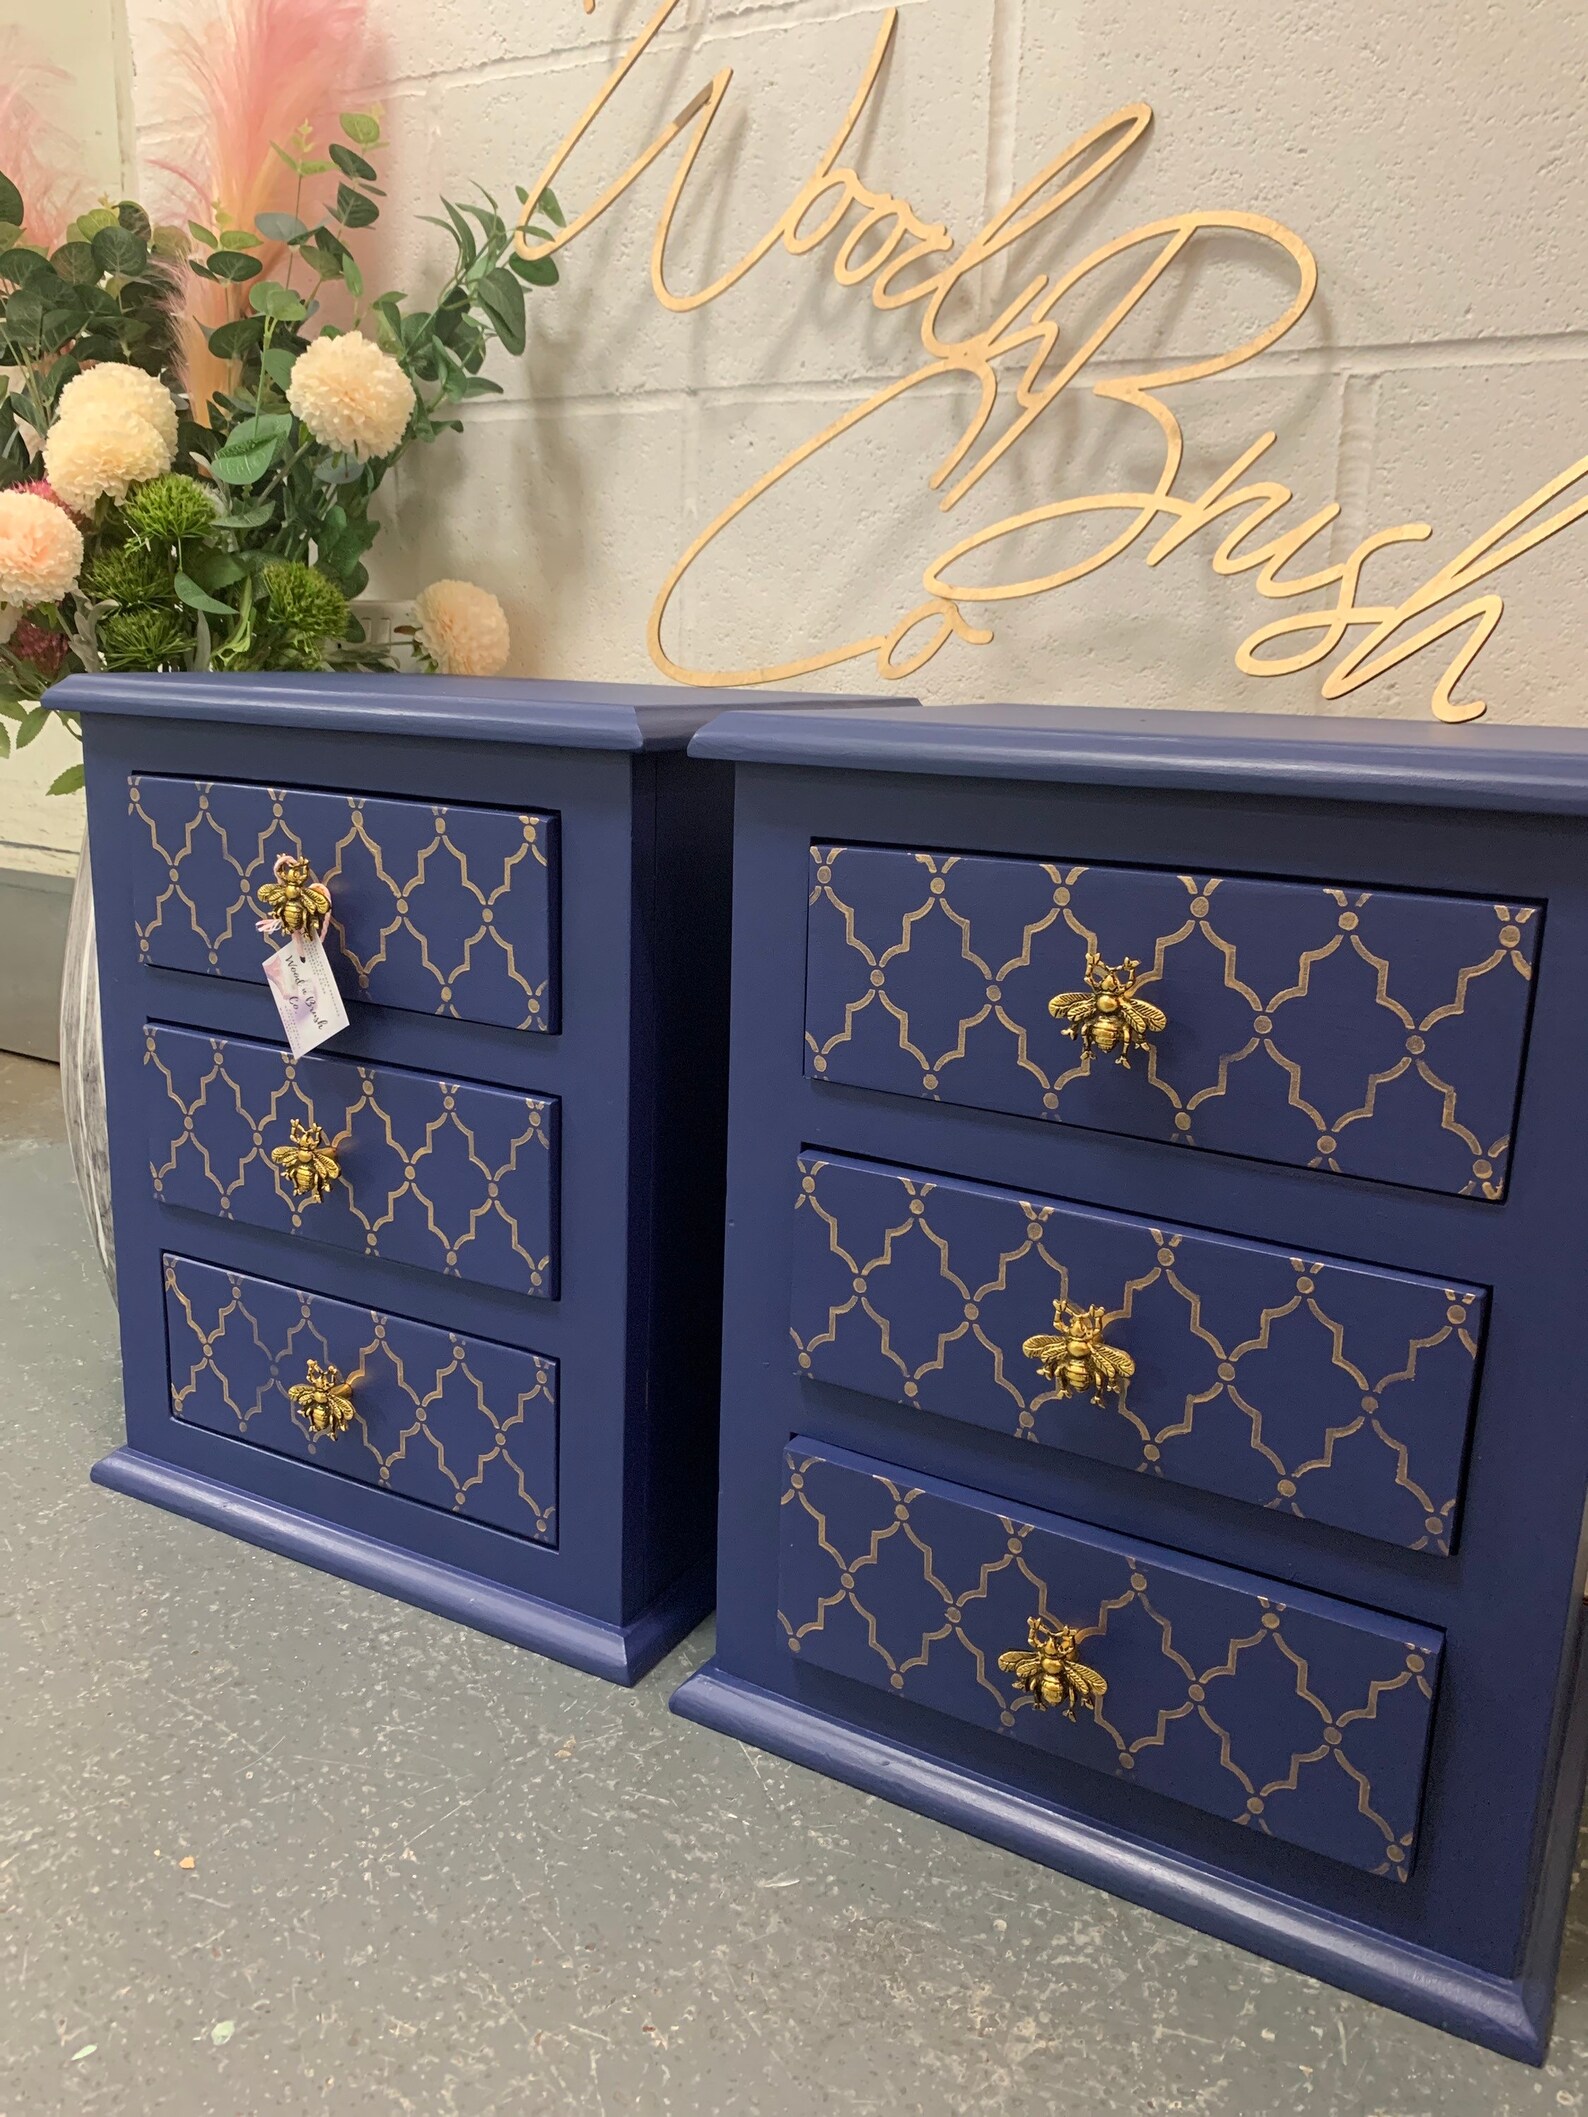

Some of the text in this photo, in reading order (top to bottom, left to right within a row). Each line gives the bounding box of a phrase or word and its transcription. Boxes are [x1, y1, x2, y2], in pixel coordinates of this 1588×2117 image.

[515, 0, 1153, 357] Wood
[923, 210, 1588, 724] Brush
[285, 955, 305, 987] Wood
[305, 996, 328, 1030] Brush
